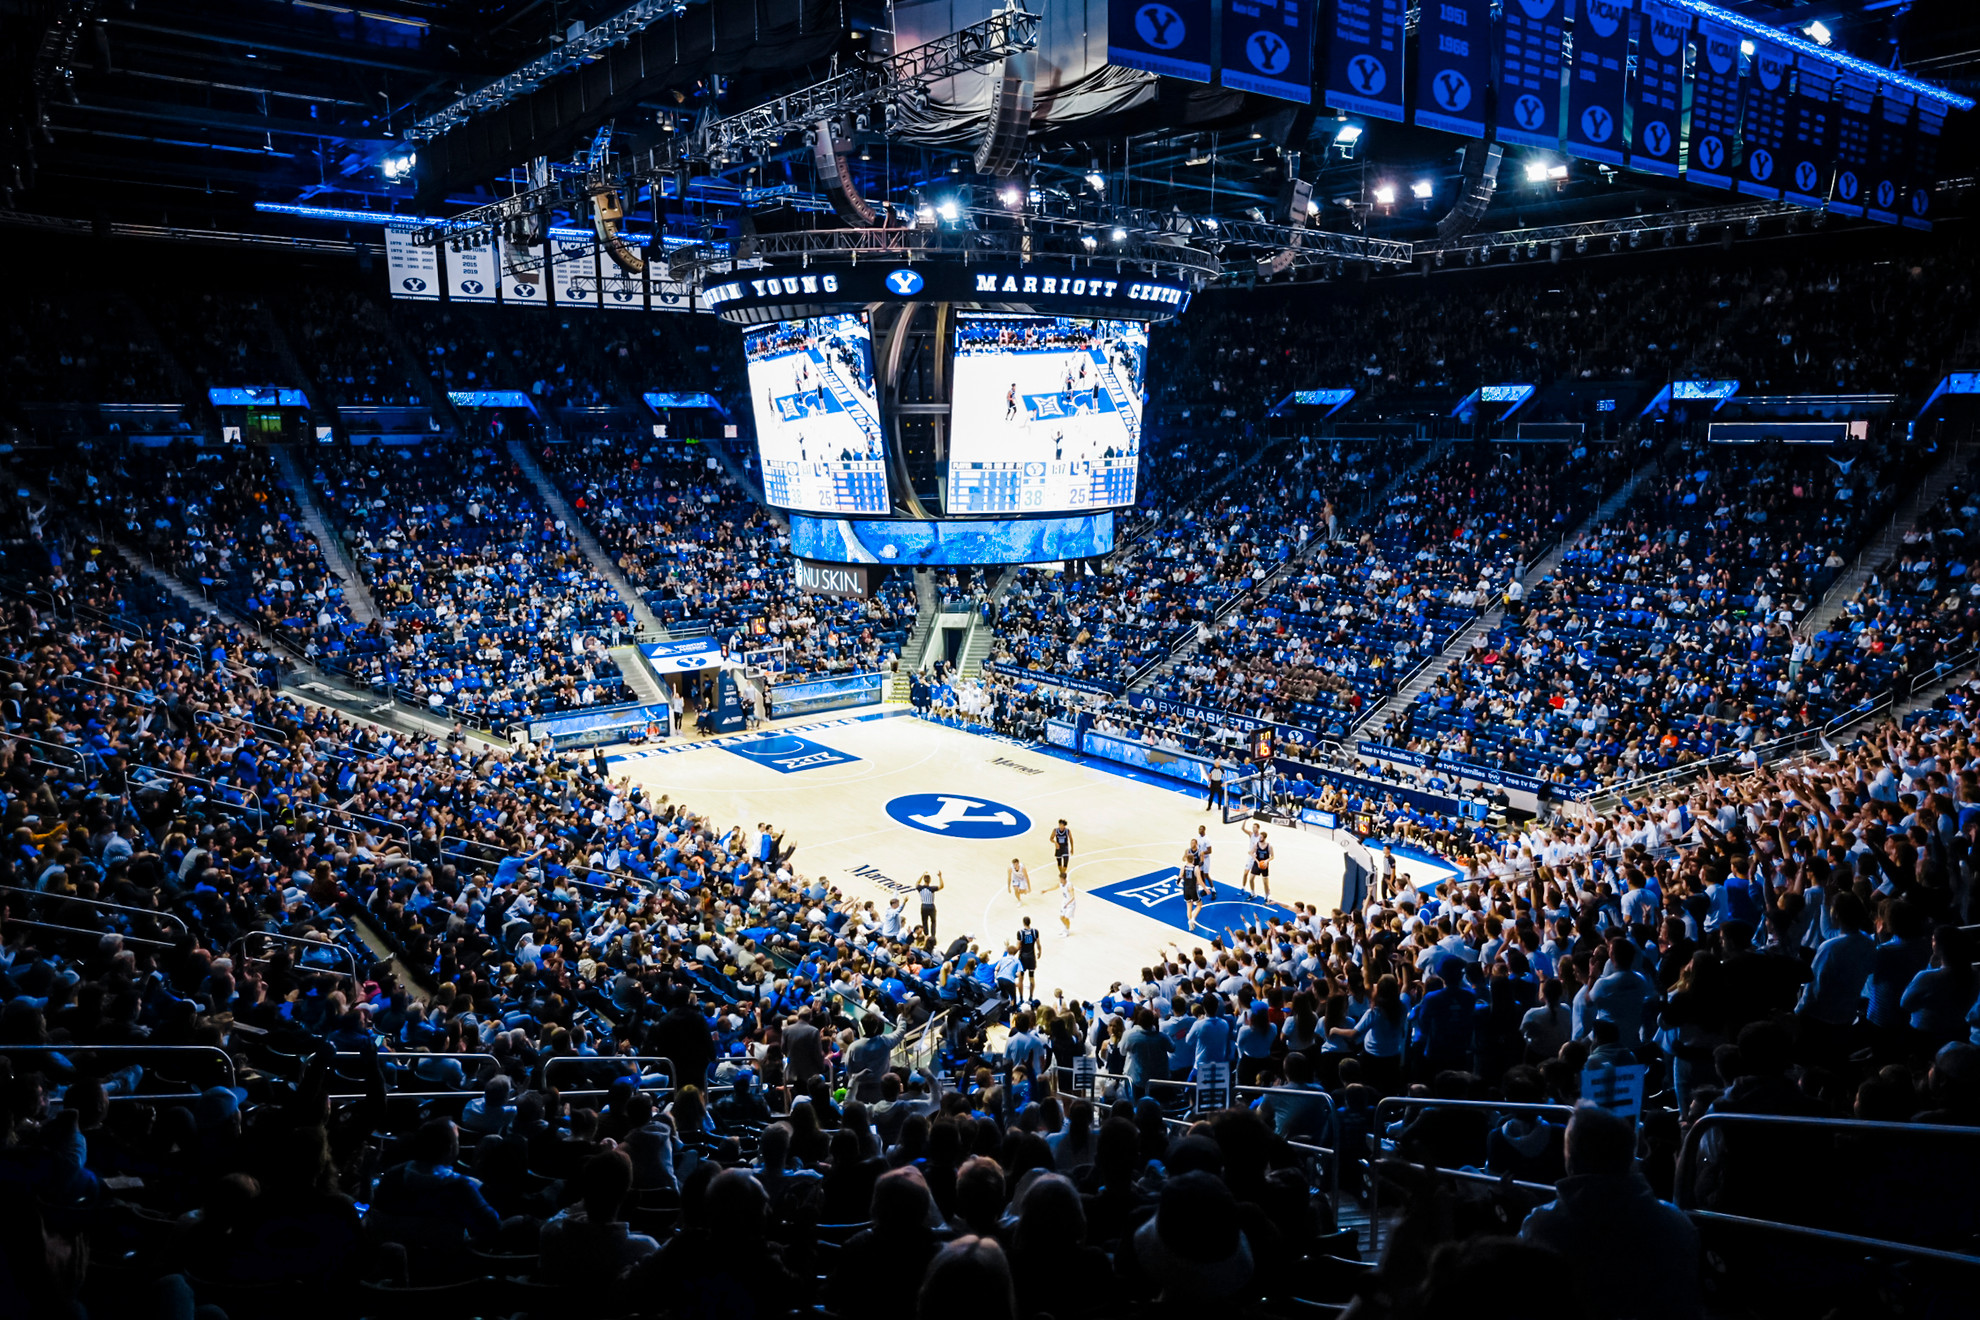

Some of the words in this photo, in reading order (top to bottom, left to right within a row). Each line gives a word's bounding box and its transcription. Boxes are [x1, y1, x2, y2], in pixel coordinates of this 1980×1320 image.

[1440, 3, 1468, 27] 1951
[1439, 34, 1470, 57] 1966
[751, 275, 838, 297] YOUNG
[890, 271, 918, 294] Y
[976, 274, 1118, 297] MARRIOTT
[818, 489, 832, 506] 25
[1024, 490, 1043, 506] 38
[1069, 488, 1086, 505] 25
[803, 566, 820, 588] NU
[624, 732, 763, 761] BRIGHAM
[765, 717, 862, 738] YOUNG
[1361, 745, 1373, 753] free
[1381, 748, 1389, 756] for
[1389, 750, 1412, 762] families
[1451, 764, 1460, 772] for
[1460, 766, 1486, 778] families
[1505, 777, 1520, 786] free
[1529, 780, 1539, 789] for
